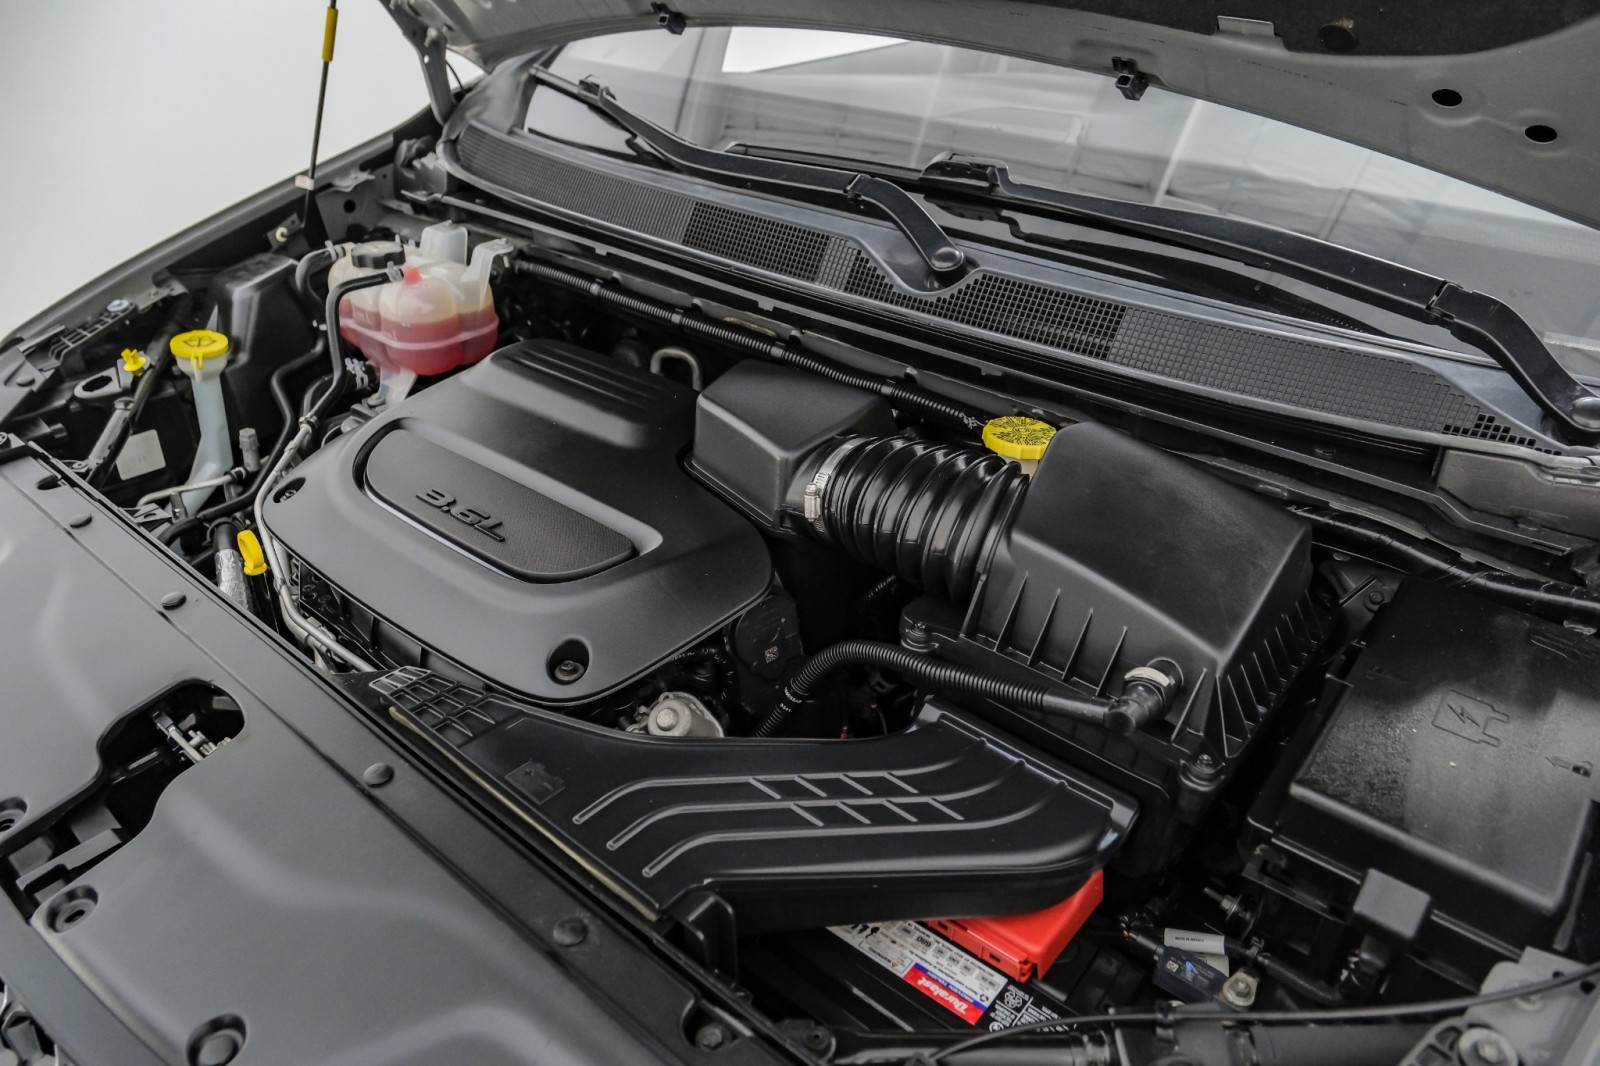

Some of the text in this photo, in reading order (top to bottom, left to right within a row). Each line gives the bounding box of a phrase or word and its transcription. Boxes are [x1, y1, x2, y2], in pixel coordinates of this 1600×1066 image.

[415, 489, 506, 543] 3.6L
[916, 936, 931, 947] 680
[917, 975, 968, 1015] Duralast
[927, 970, 974, 1003] PROVEN TOUGH
